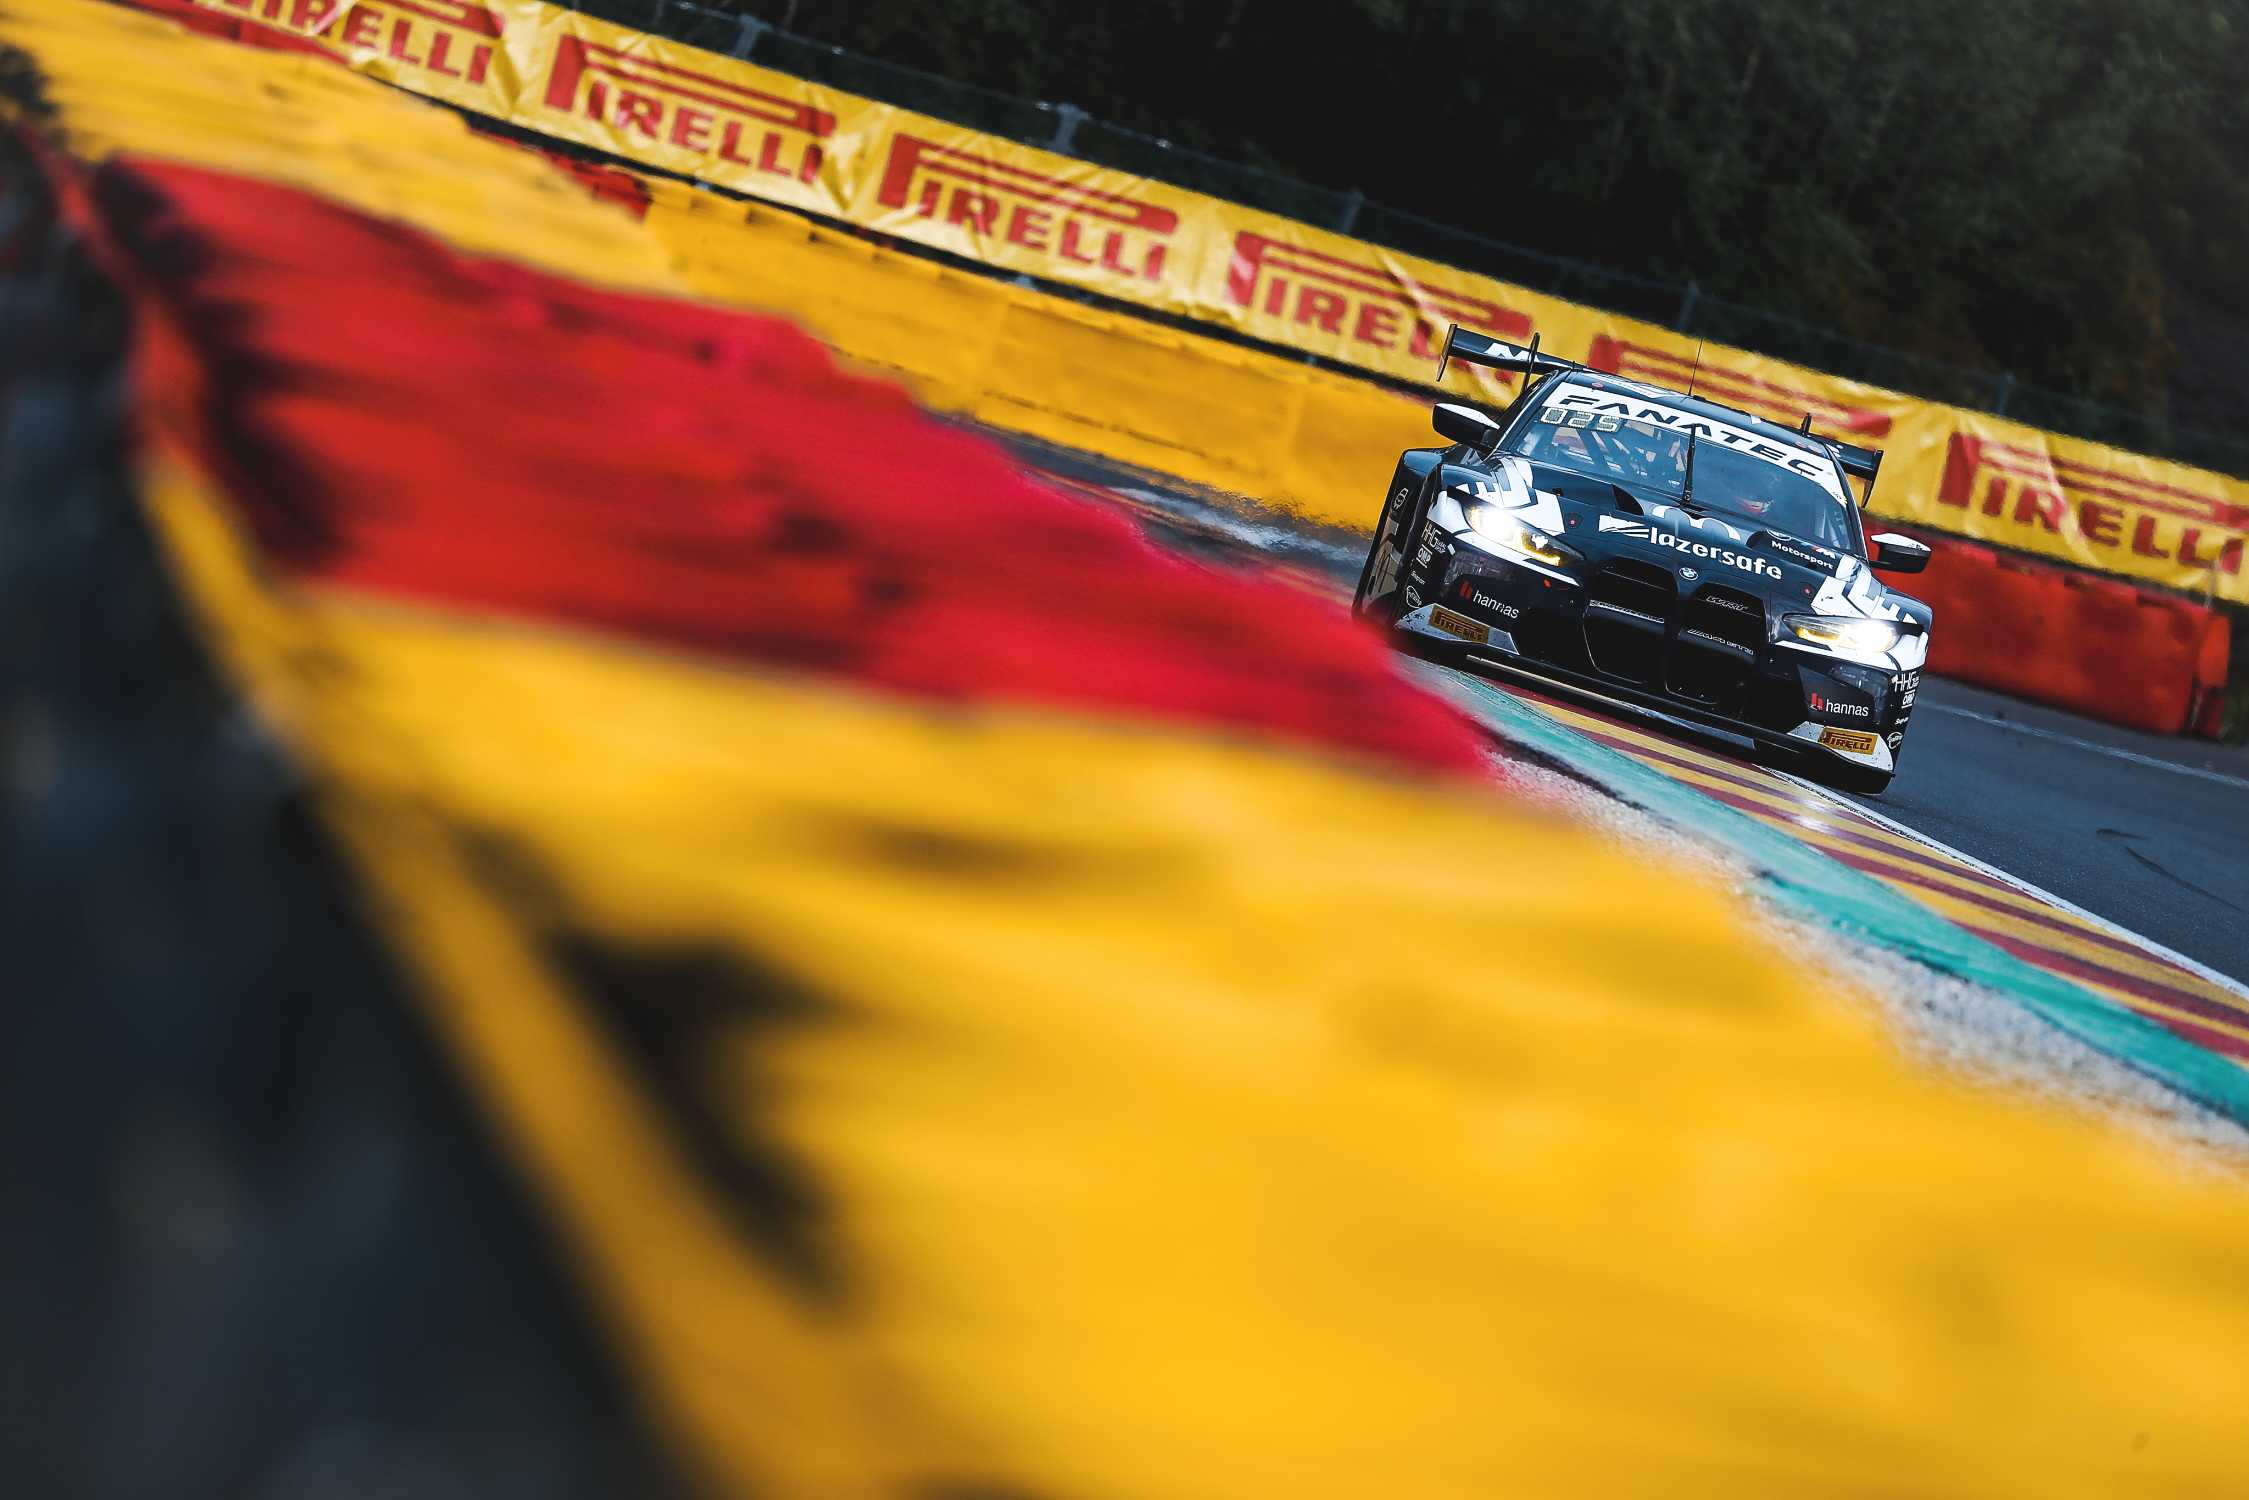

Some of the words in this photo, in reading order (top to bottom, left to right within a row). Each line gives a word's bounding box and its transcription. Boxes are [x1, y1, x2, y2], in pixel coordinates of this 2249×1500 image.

[216, 0, 505, 85] IRELLI
[544, 33, 837, 184] PIRELLI
[877, 132, 1179, 282] PIRELLI
[1227, 229, 1533, 386] PIREL
[1559, 394, 1825, 477] FANATEC
[1937, 431, 2249, 576] PIRELLI
[1650, 527, 1783, 580] lazersafe
[1771, 540, 1834, 570] Motorsport
[1473, 590, 1520, 619] hannas
[1822, 731, 1873, 751] PIRELLI
[1825, 699, 1869, 717] hannas
